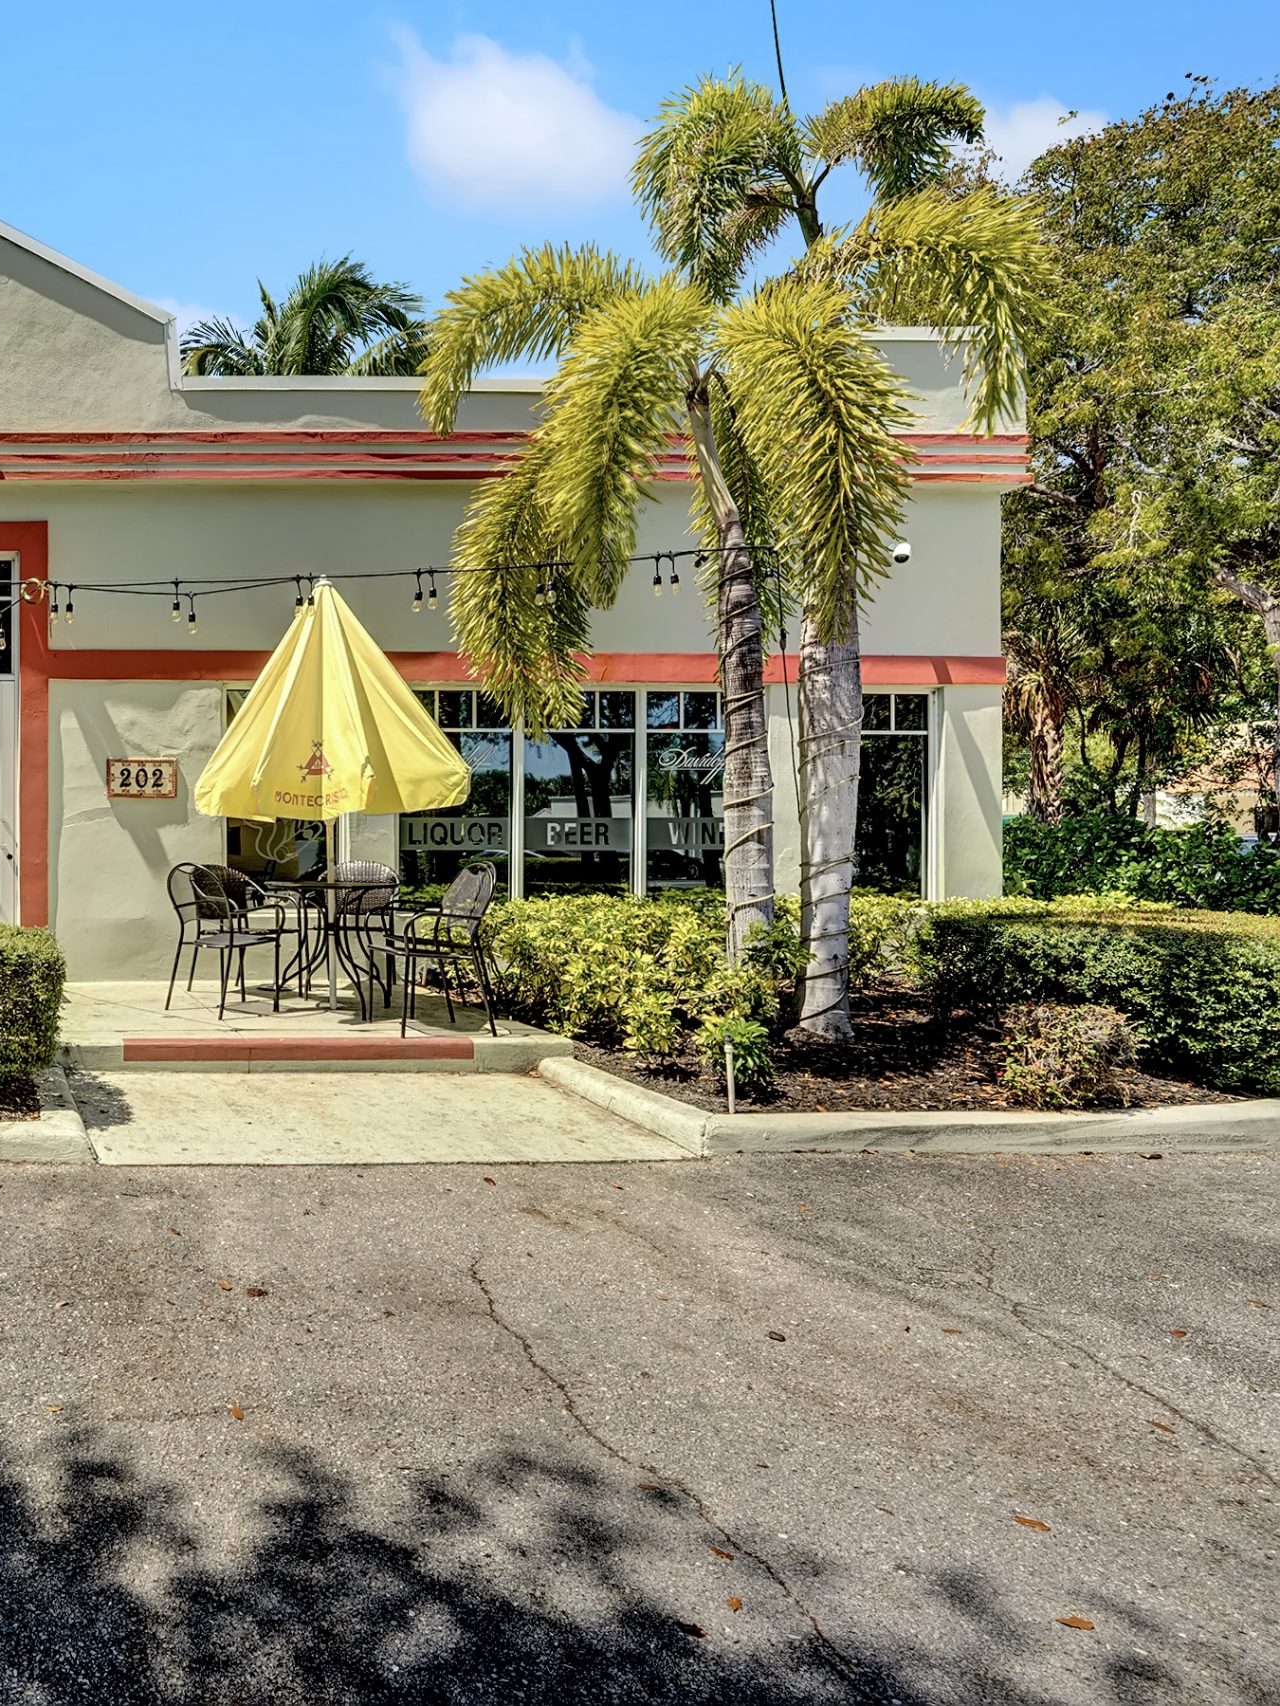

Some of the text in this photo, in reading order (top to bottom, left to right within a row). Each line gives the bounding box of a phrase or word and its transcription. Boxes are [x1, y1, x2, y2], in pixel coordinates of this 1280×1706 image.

[119, 768, 164, 788] 202
[408, 822, 503, 846] LIQUOR
[547, 822, 609, 845] BEER
